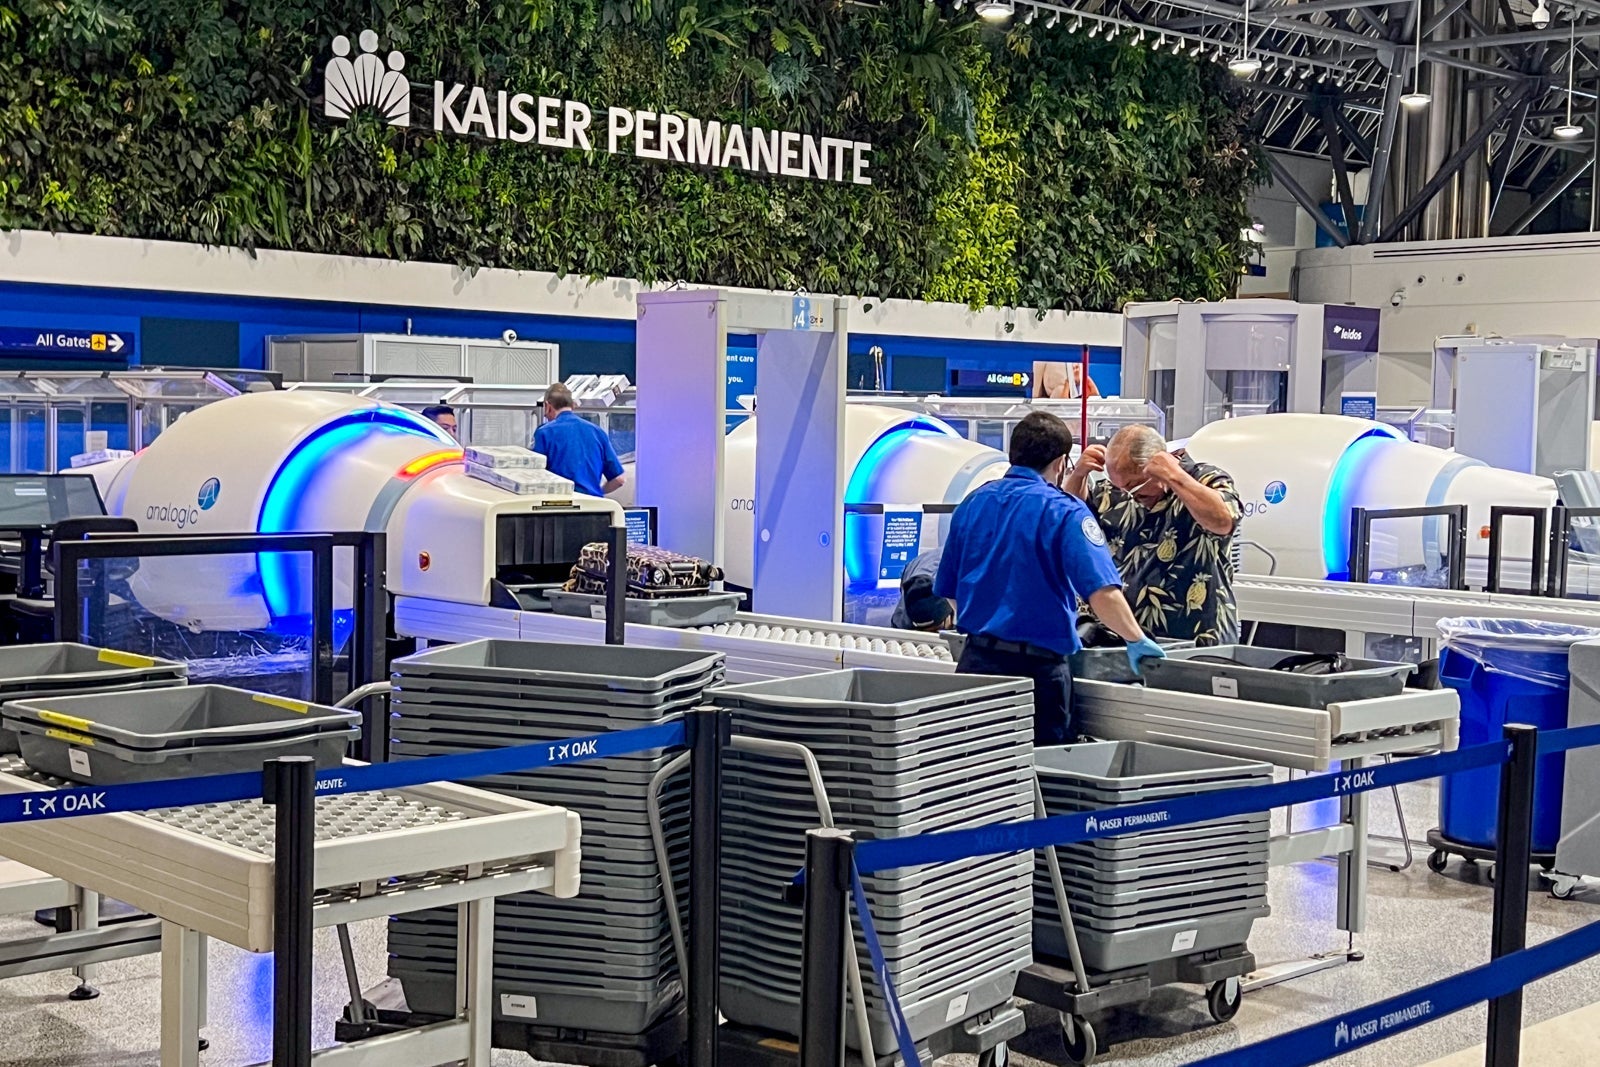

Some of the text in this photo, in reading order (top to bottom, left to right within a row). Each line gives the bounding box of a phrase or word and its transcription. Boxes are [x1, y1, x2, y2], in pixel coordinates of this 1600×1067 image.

[433, 79, 872, 185] KAISER PERMANENTE
[36, 333, 91, 349] All Gates
[1340, 327, 1362, 340] leidos
[739, 355, 755, 363] care
[986, 373, 1014, 384] All Gates
[146, 501, 199, 530] analogic
[548, 739, 598, 761] I OAK
[1333, 770, 1375, 792] I OAK
[22, 791, 106, 815] I OAK
[1099, 810, 1168, 831] KAISER PERMANENTE
[1351, 1000, 1431, 1041] KAISER PERMANENTE
